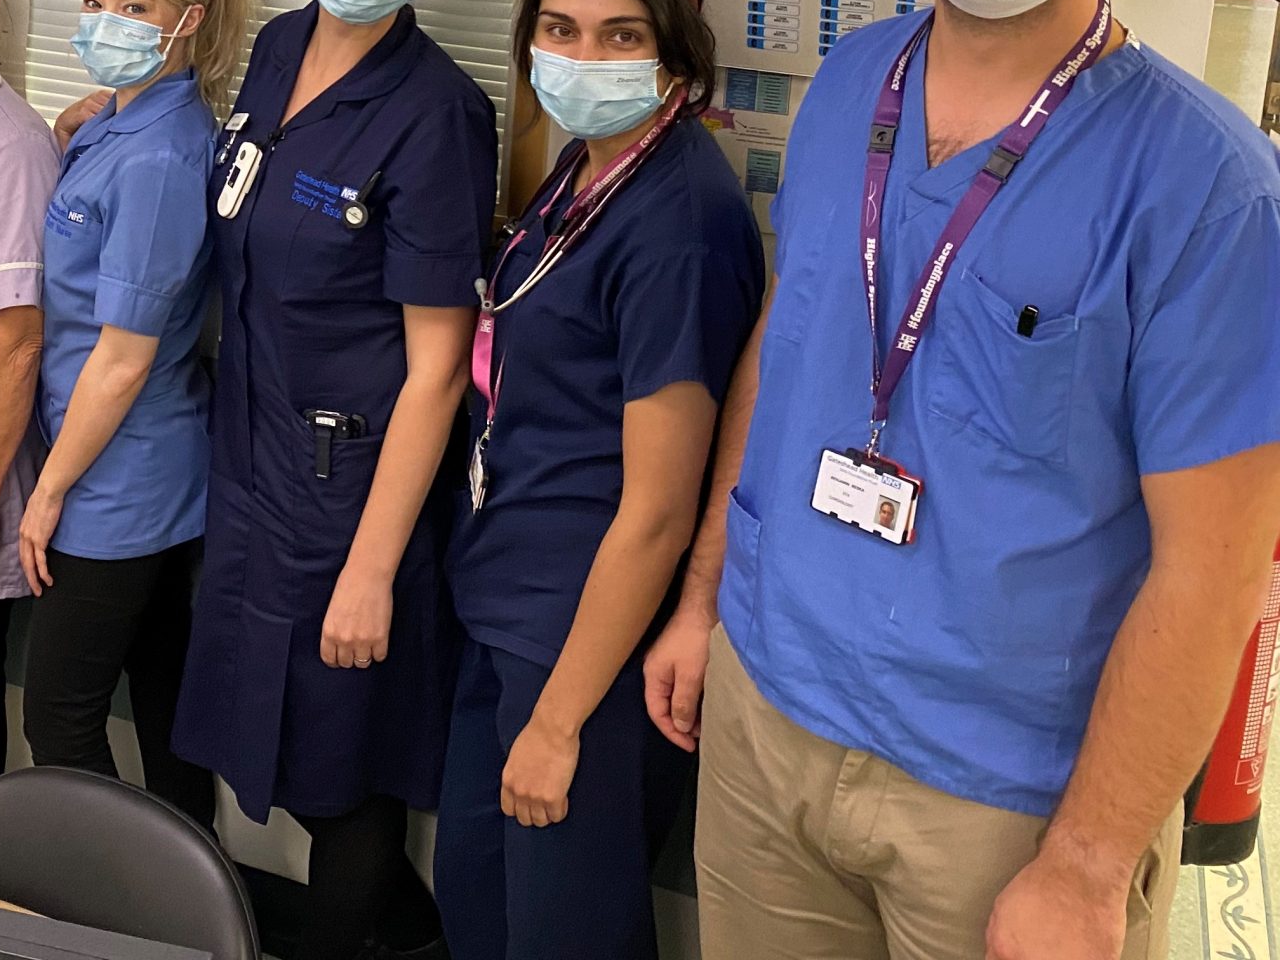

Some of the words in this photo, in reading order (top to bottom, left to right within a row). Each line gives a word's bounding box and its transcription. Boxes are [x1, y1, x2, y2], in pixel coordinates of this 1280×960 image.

[1051, 47, 1090, 87] Higher
[291, 189, 319, 211] Deputy
[322, 202, 342, 220] Siste
[341, 186, 359, 200] NHS
[68, 211, 85, 224] NHS
[864, 237, 876, 284] Higher
[908, 241, 954, 330] #foundmyplace
[882, 477, 900, 489] NHS
